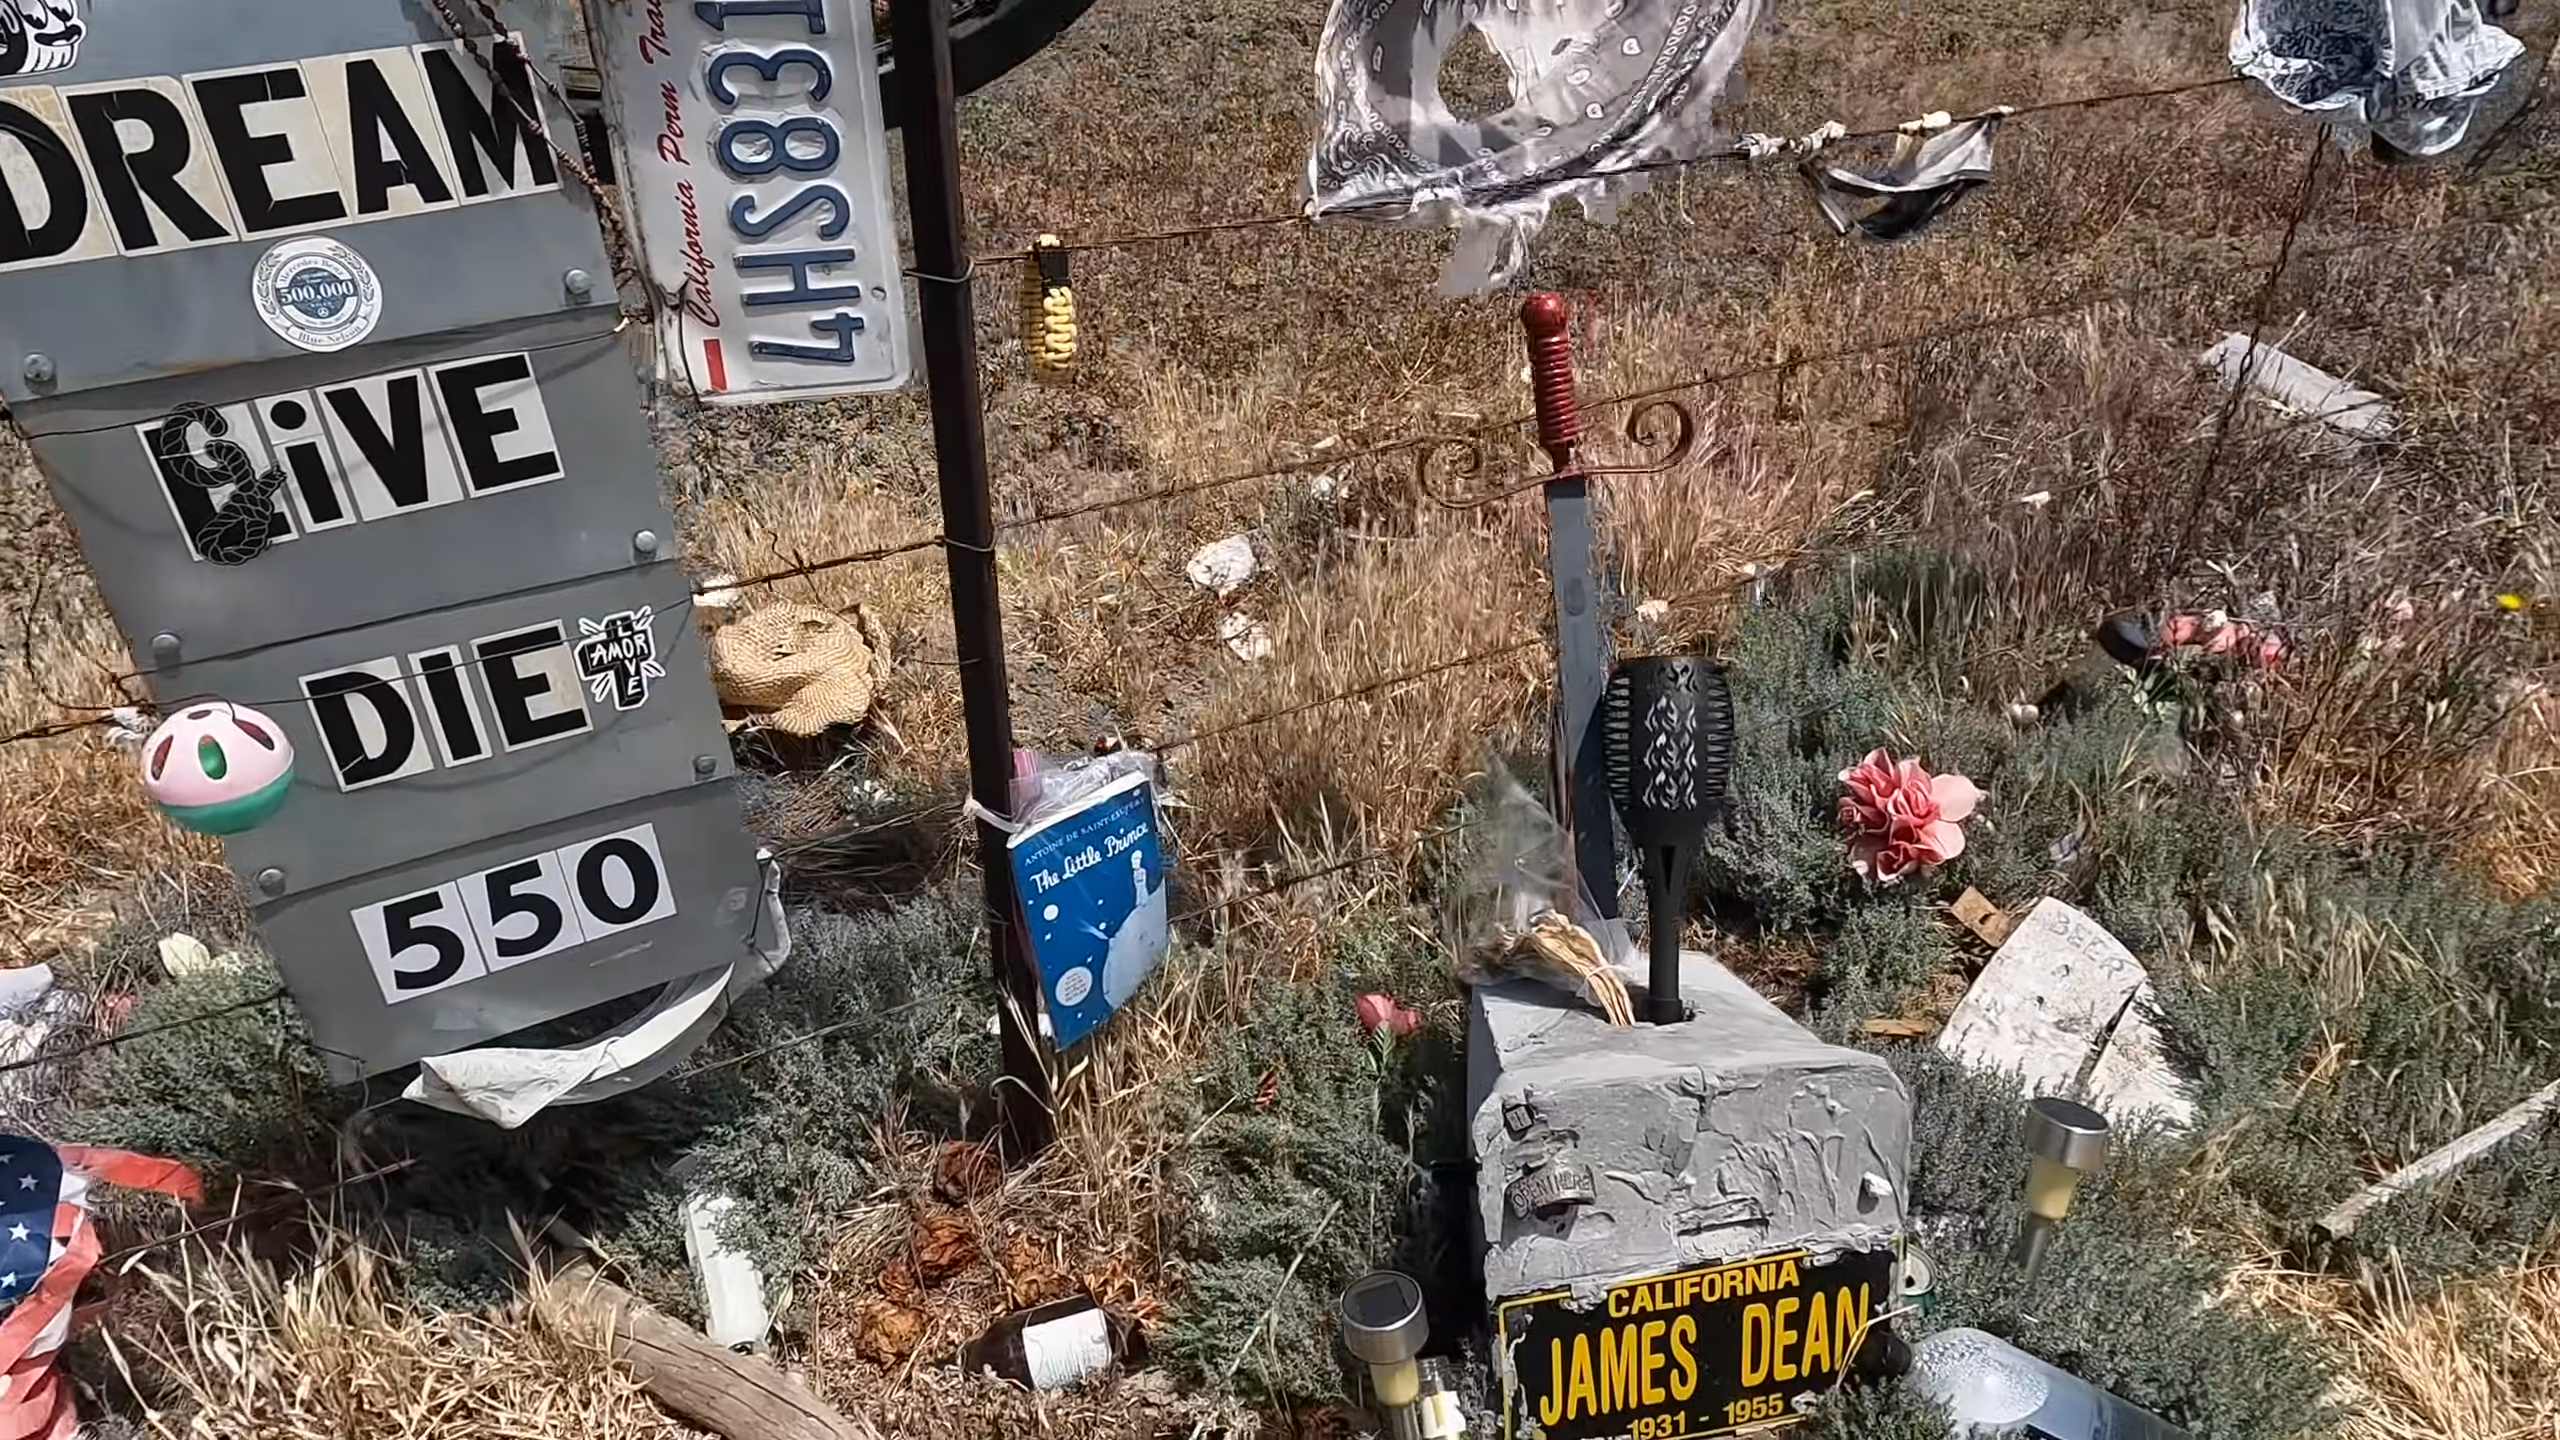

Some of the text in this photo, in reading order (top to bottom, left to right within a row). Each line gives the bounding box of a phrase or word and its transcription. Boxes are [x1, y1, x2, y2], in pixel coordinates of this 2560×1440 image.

[656, 81, 691, 165] Perm
[675, 180, 721, 328] California
[590, 634, 648, 666] AMOR
[306, 627, 590, 784] DIE
[1025, 837, 1063, 867] ANTOINE
[1065, 830, 1079, 843] DE
[1029, 822, 1149, 894] The Little Prince
[382, 838, 660, 990] 550
[2049, 911, 2140, 980] BEER
[1608, 1259, 1799, 1318] CALIFORNIA
[1540, 1282, 1868, 1426] JAMES DEAN
[1627, 1410, 1686, 1440] 1931
[1723, 1392, 1783, 1425] 1955
